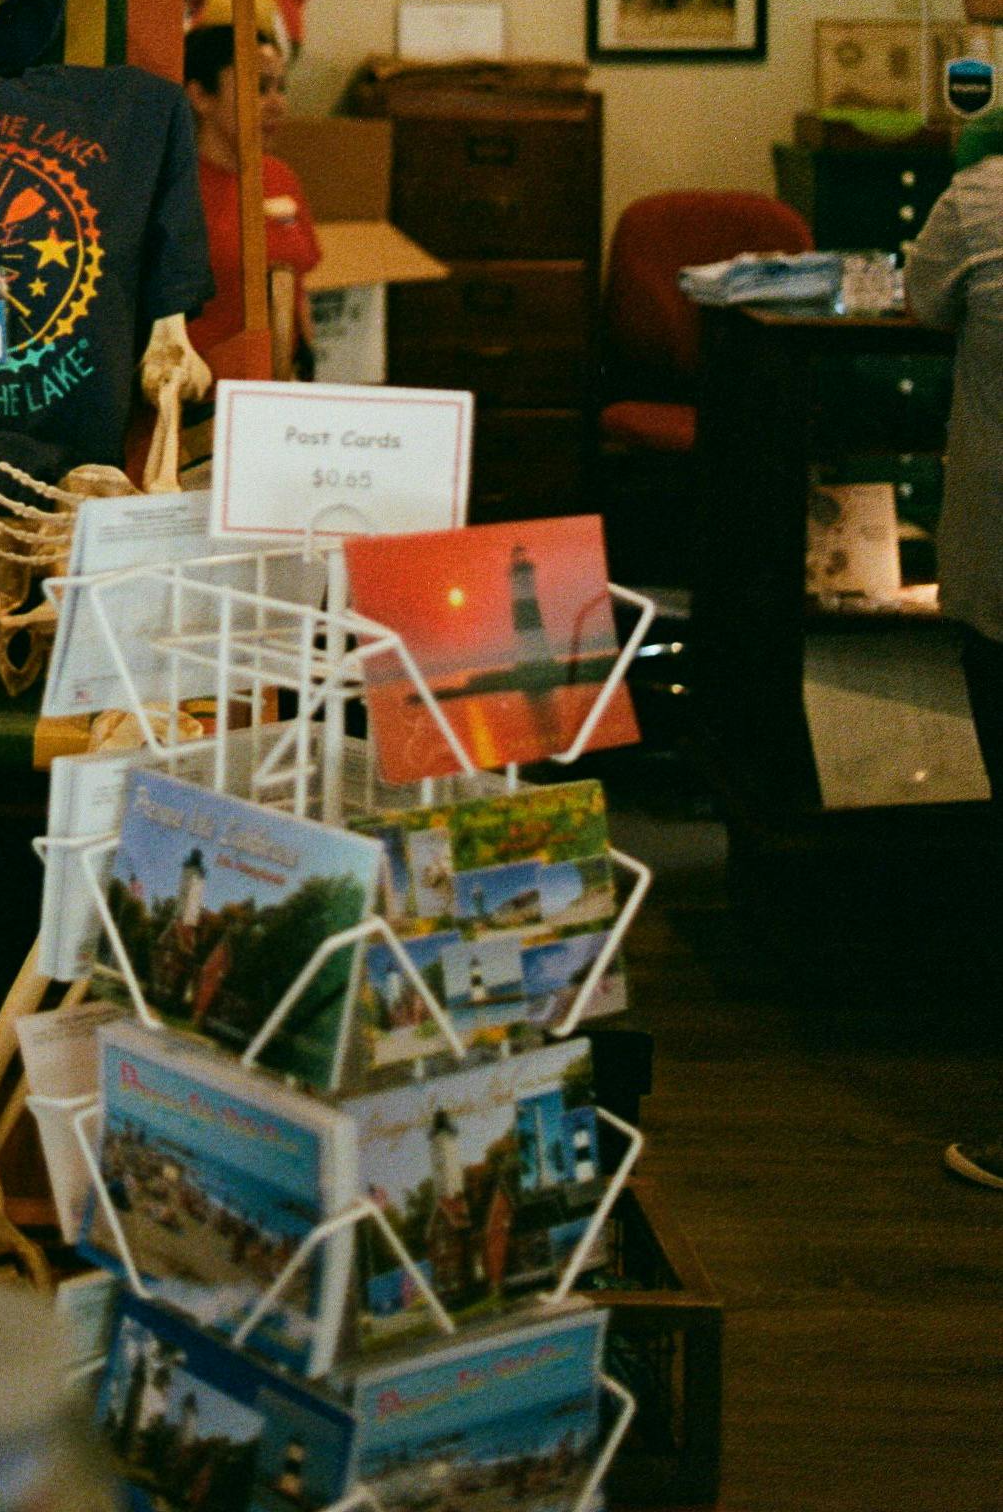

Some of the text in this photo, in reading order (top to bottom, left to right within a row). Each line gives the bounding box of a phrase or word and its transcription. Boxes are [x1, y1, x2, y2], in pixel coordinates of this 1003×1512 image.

[284, 425, 400, 449] Post Cards
[312, 467, 372, 488] $0.65
